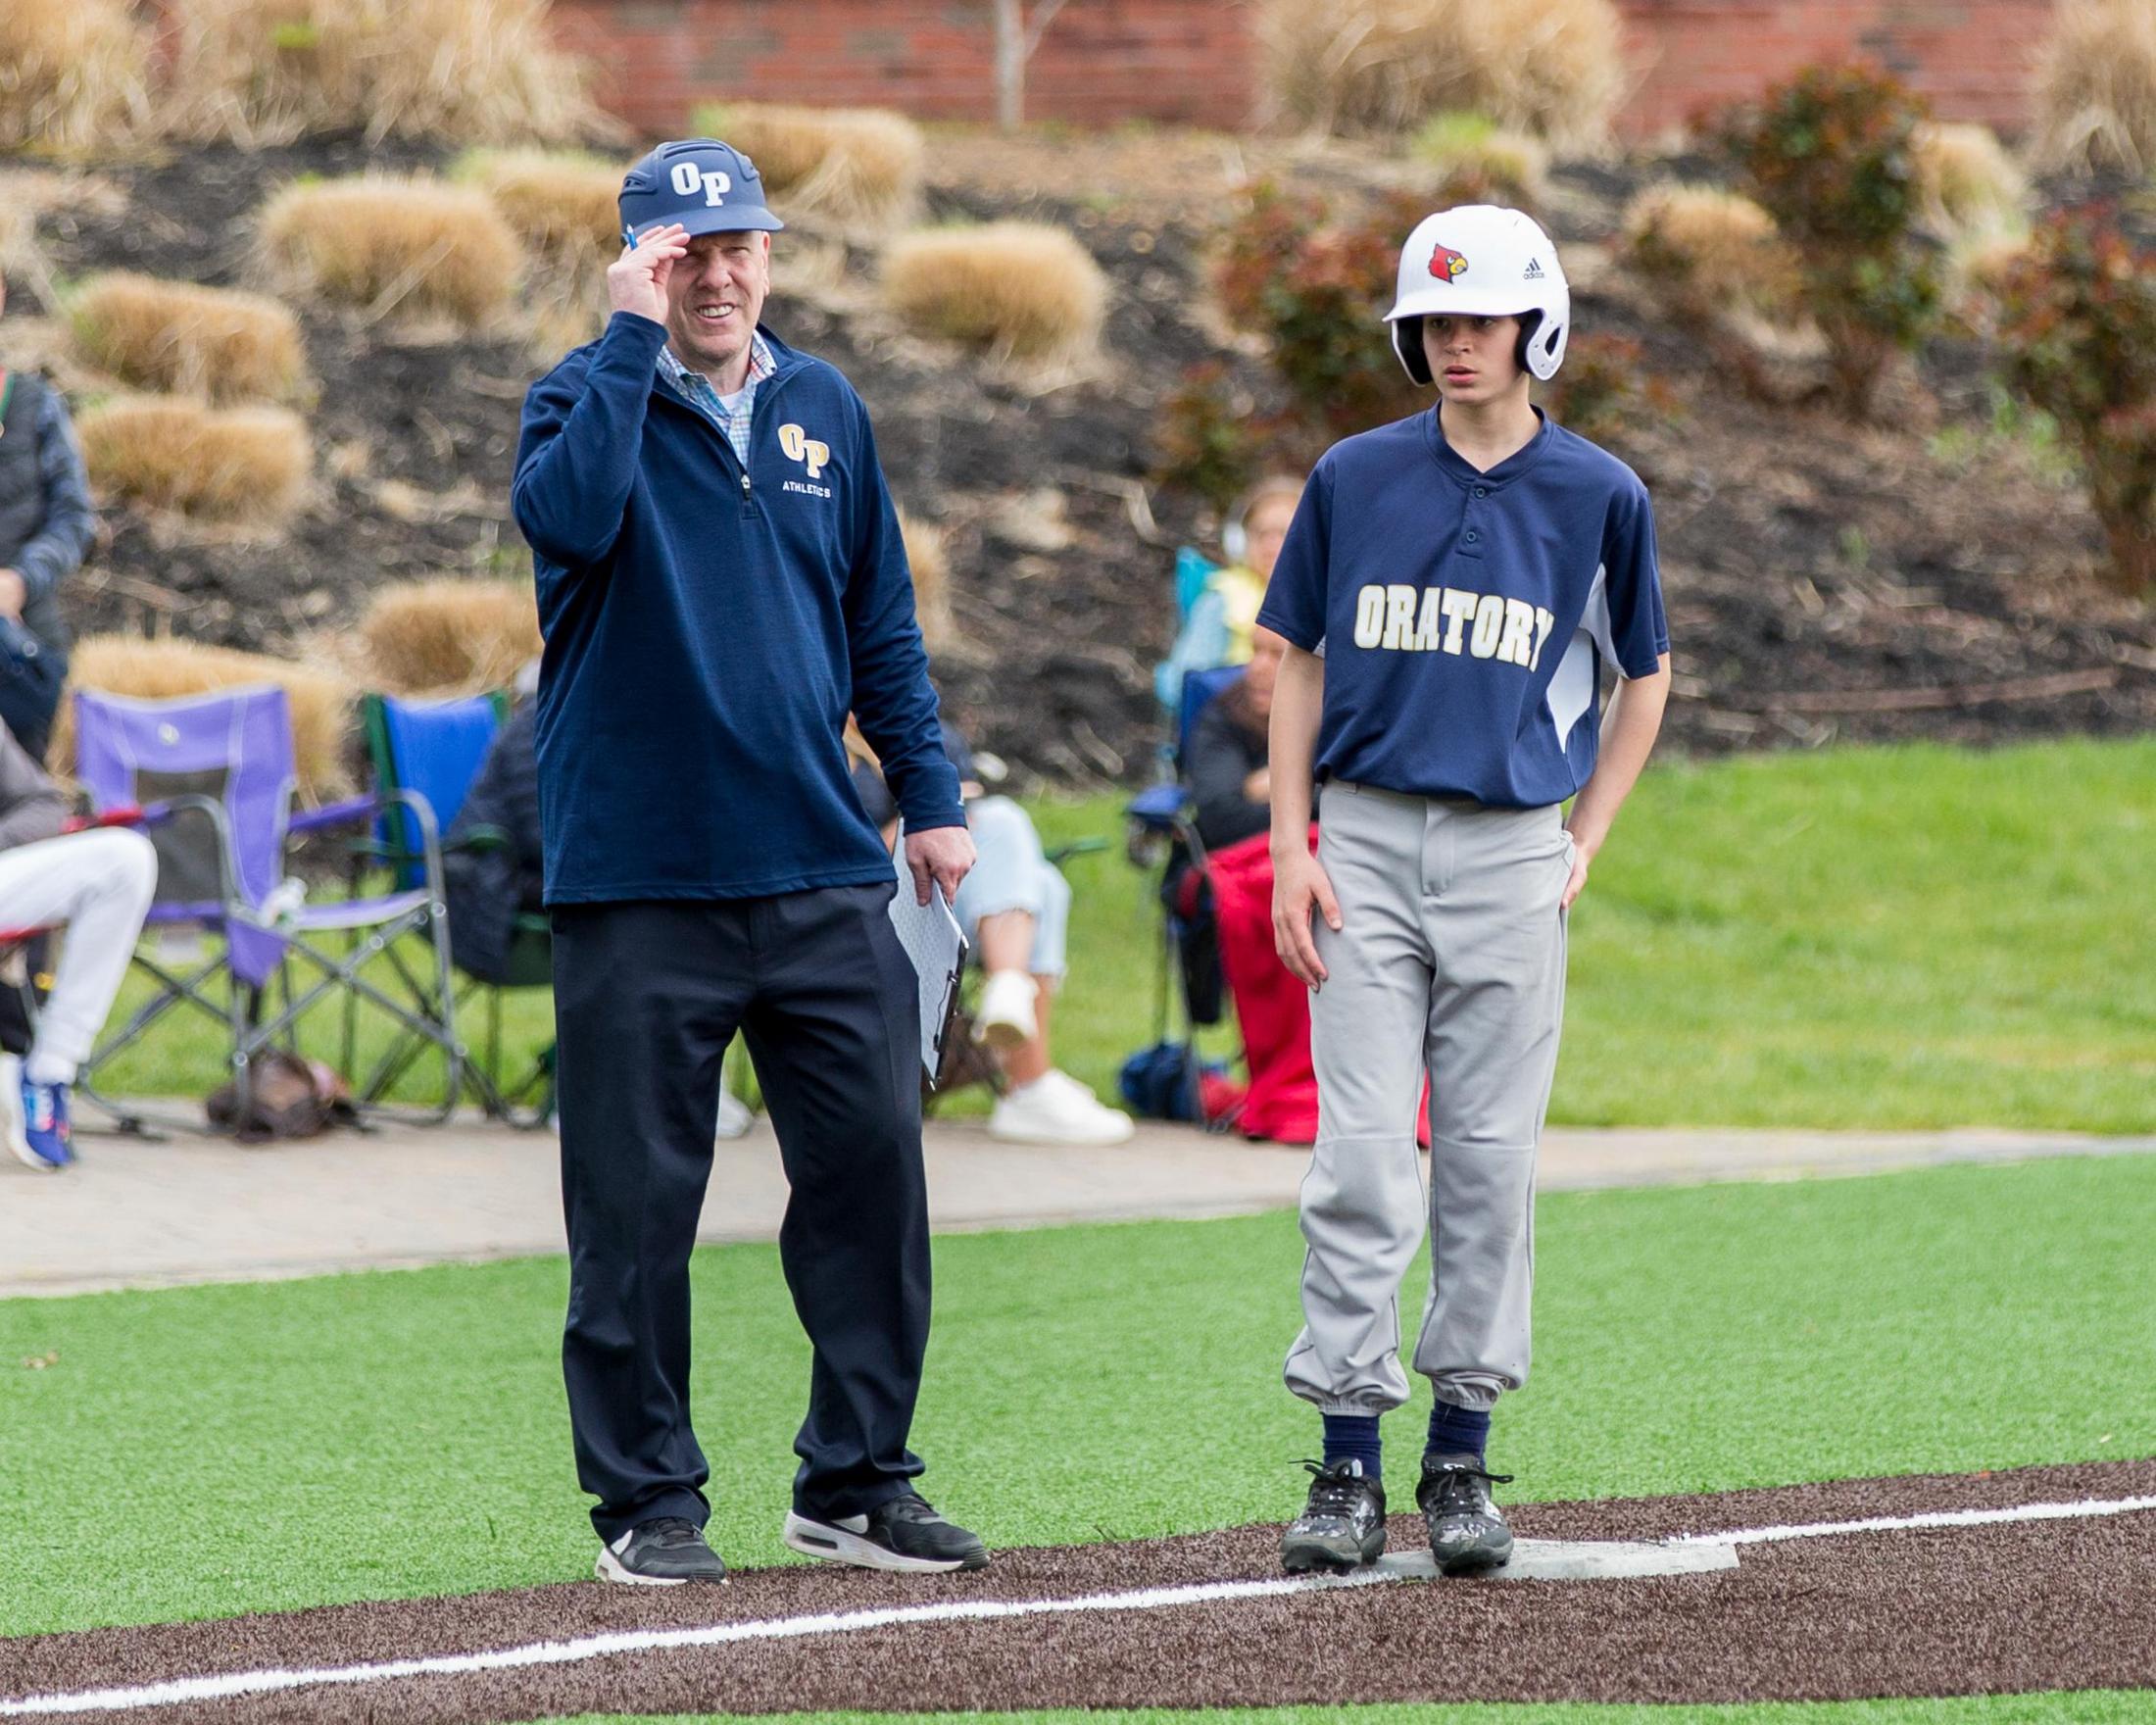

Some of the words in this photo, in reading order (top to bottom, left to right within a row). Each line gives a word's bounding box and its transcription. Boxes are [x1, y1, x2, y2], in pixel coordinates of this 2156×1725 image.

[670, 162, 731, 207] OP
[778, 423, 830, 479] OP
[782, 480, 831, 498] ATHLETICS
[1353, 584, 1555, 673] ORATORY
